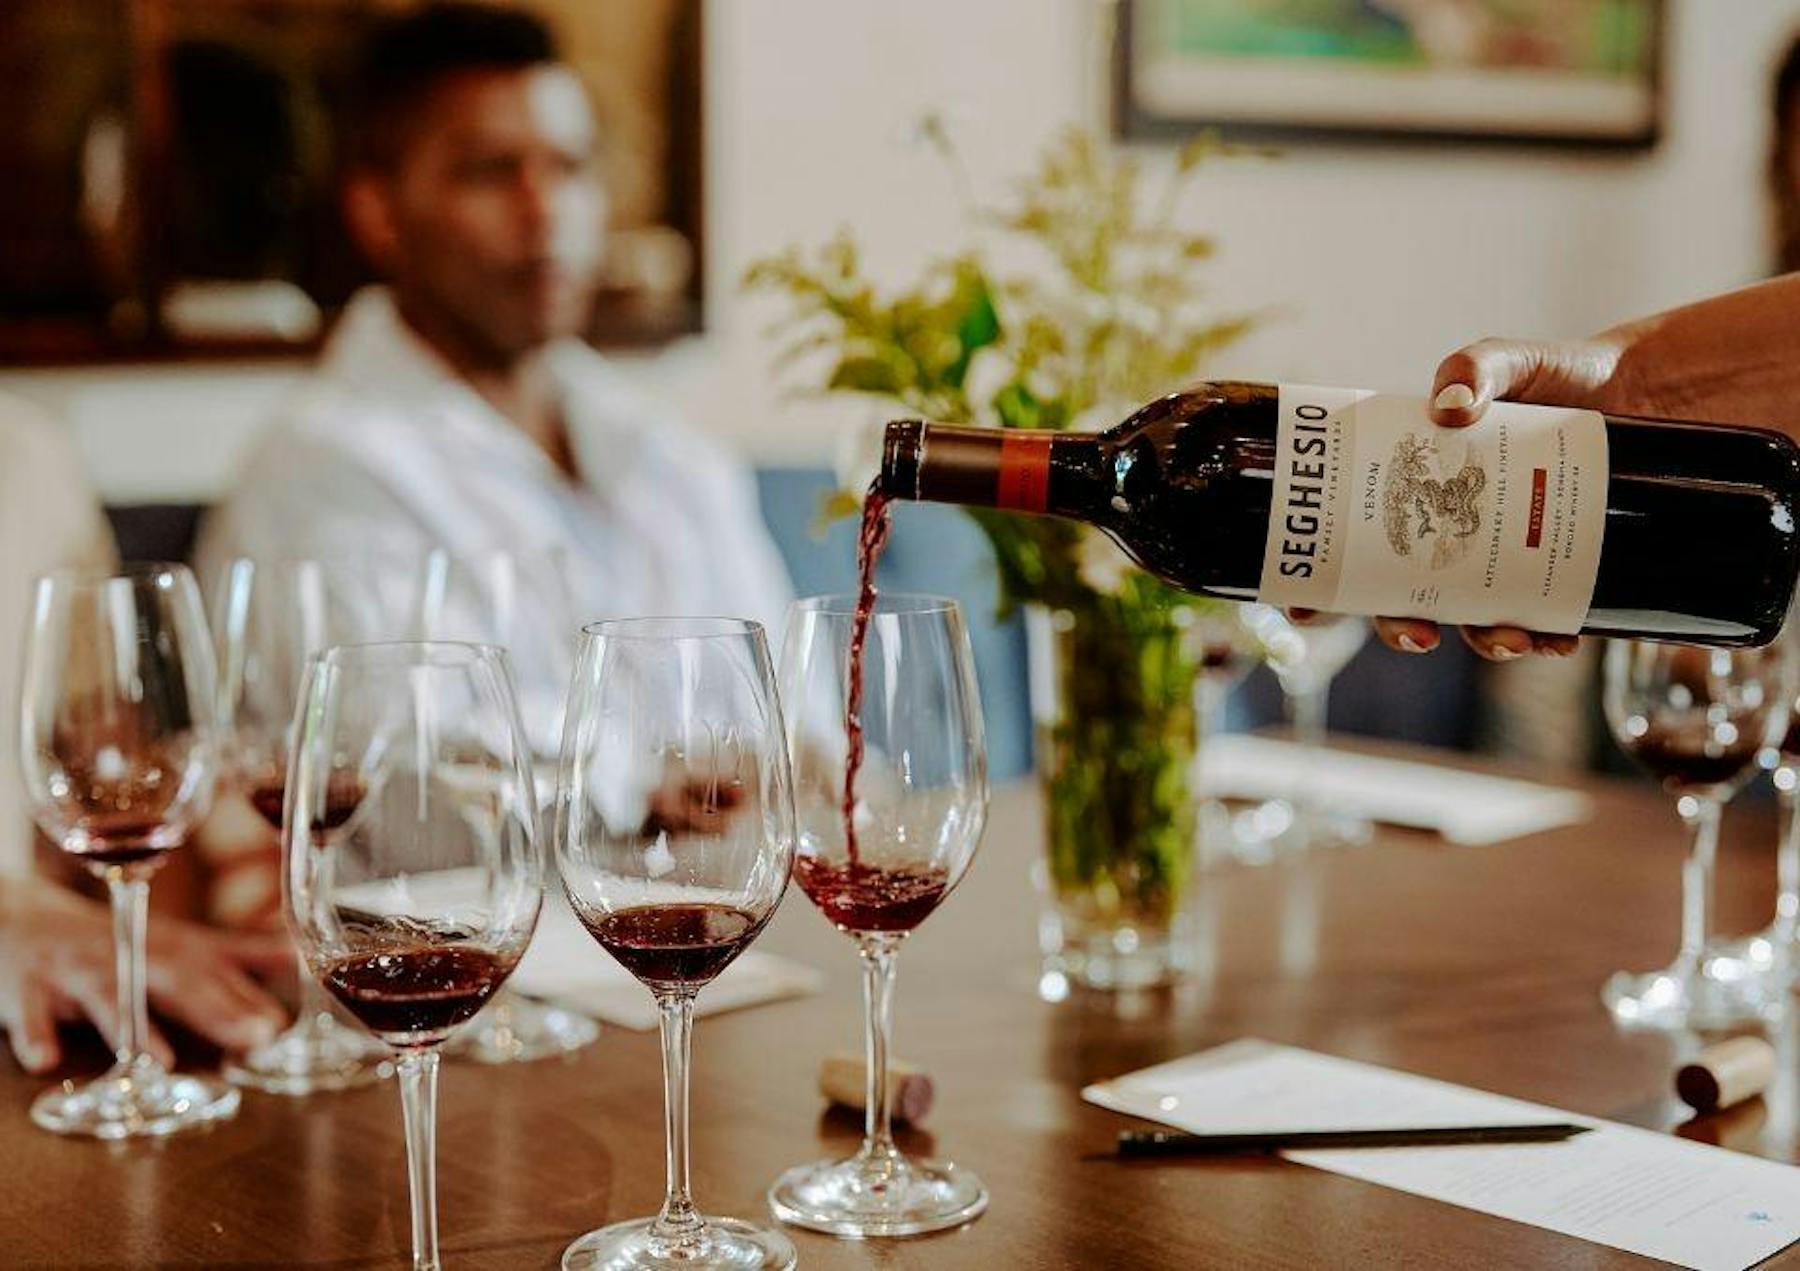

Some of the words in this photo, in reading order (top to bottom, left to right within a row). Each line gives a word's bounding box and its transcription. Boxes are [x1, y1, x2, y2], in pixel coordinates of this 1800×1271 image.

[1280, 404, 1328, 578] SEGHESIO
[1364, 462, 1381, 521] VENOM
[1321, 510, 1334, 563] FAMILY
